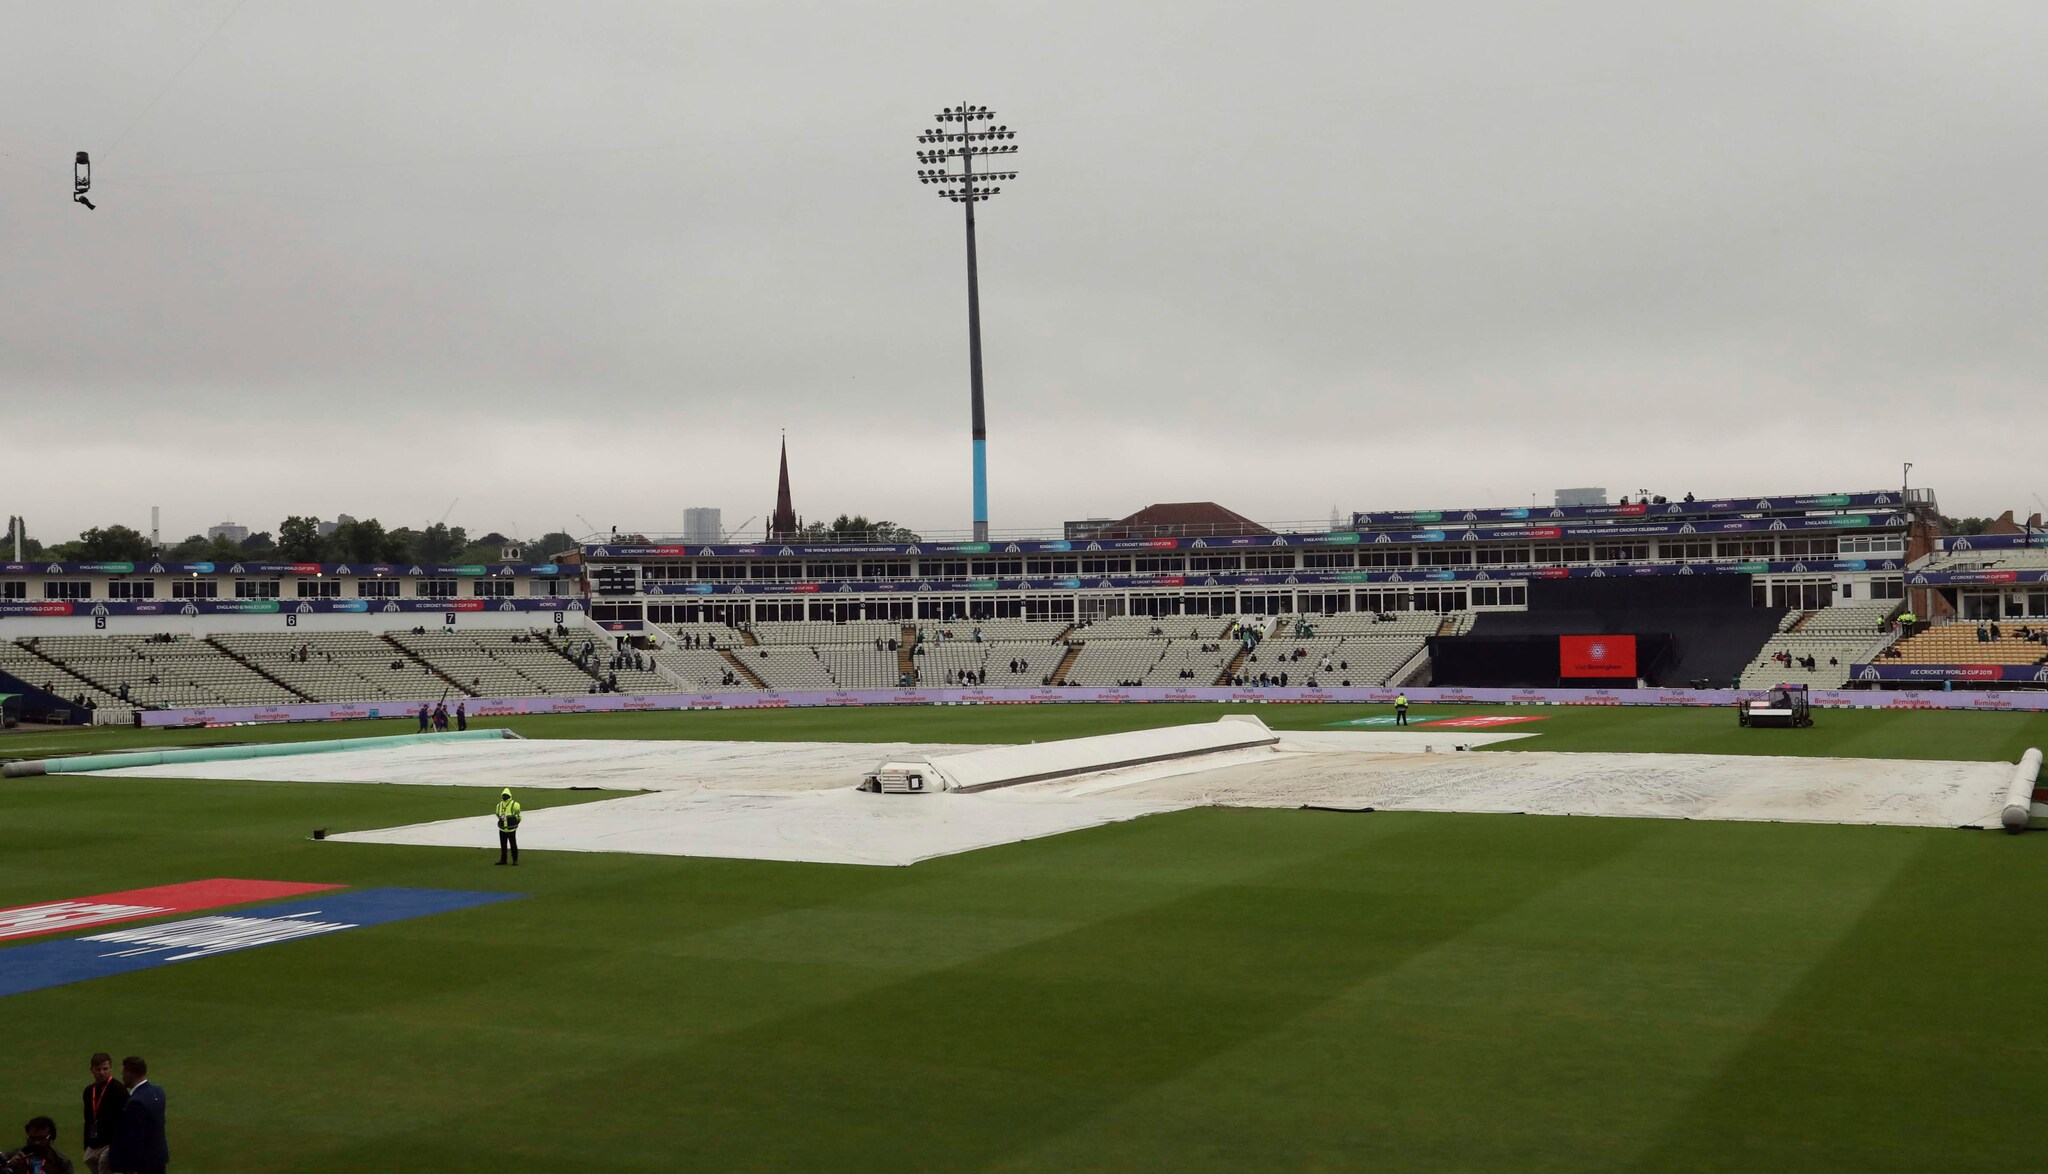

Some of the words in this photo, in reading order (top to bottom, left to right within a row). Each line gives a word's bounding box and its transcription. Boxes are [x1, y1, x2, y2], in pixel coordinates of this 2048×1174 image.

[288, 616, 295, 625] 6
[447, 614, 454, 622] 7
[556, 613, 561, 622] 8
[97, 618, 104, 627] 5
